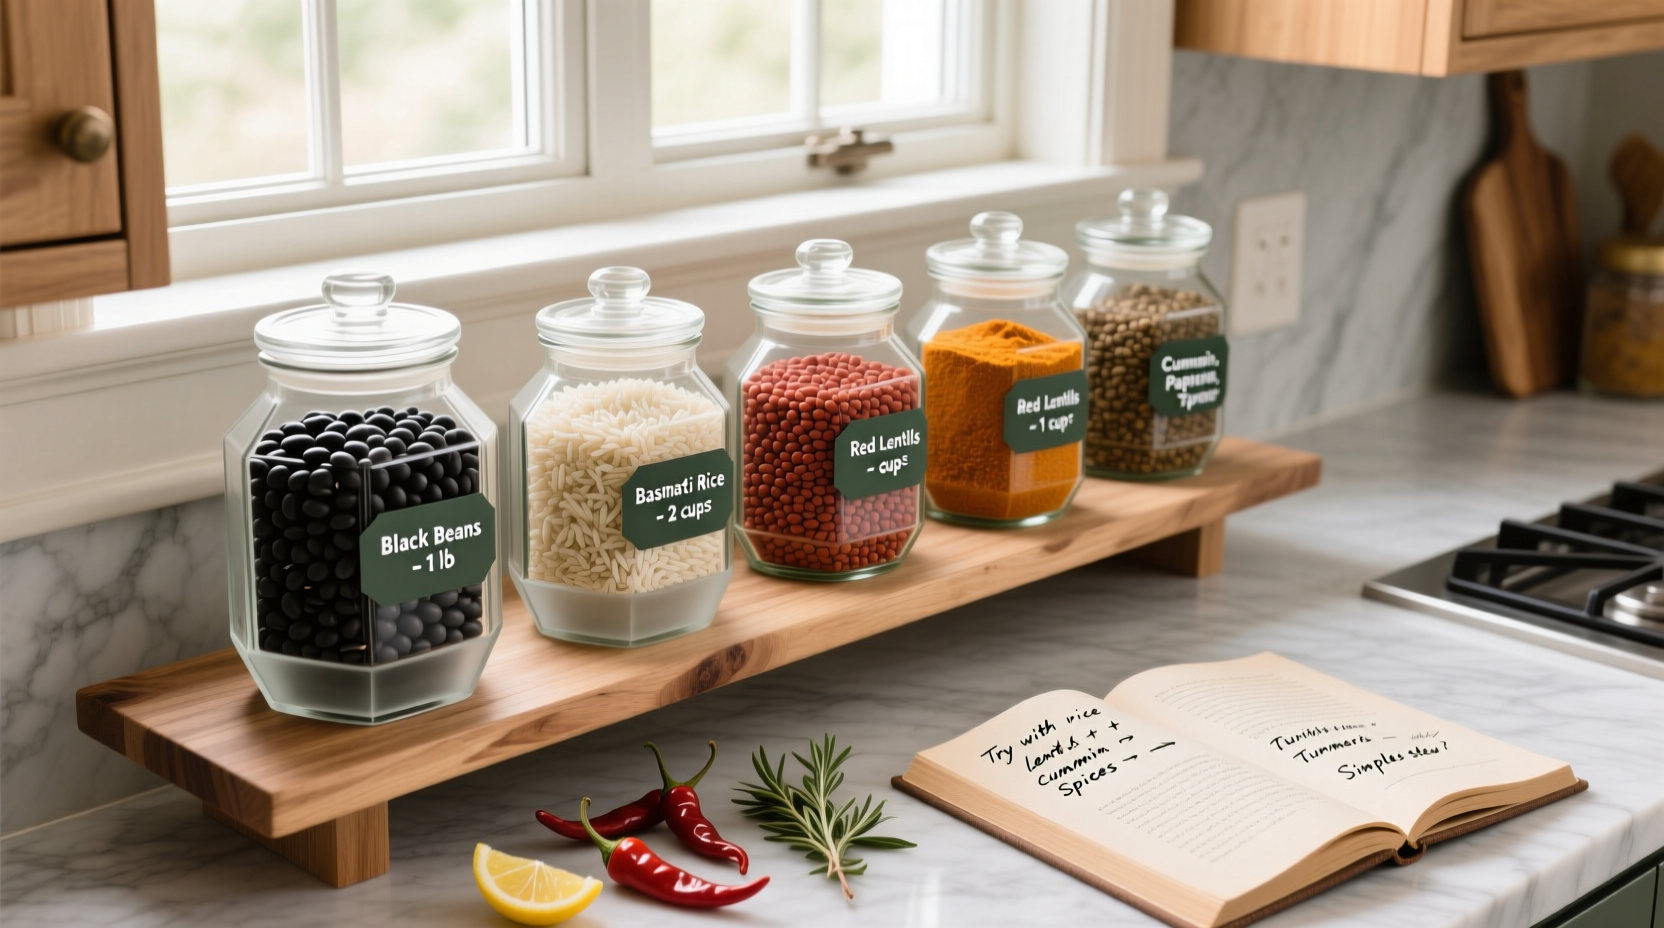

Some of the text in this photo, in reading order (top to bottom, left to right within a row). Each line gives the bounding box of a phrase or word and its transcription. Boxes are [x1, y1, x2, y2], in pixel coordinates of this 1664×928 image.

[1017, 395, 1041, 415] Red
[1039, 416, 1045, 433] 1
[850, 435, 876, 457] Red
[878, 454, 909, 477] cups
[635, 471, 725, 505] Basmati Rice
[668, 504, 677, 523] 2
[680, 499, 712, 521] cups
[381, 521, 482, 556] Black Beans
[426, 553, 434, 572] 1
[439, 548, 455, 570] lb
[980, 745, 1013, 765] Try
[1020, 719, 1056, 746] with
